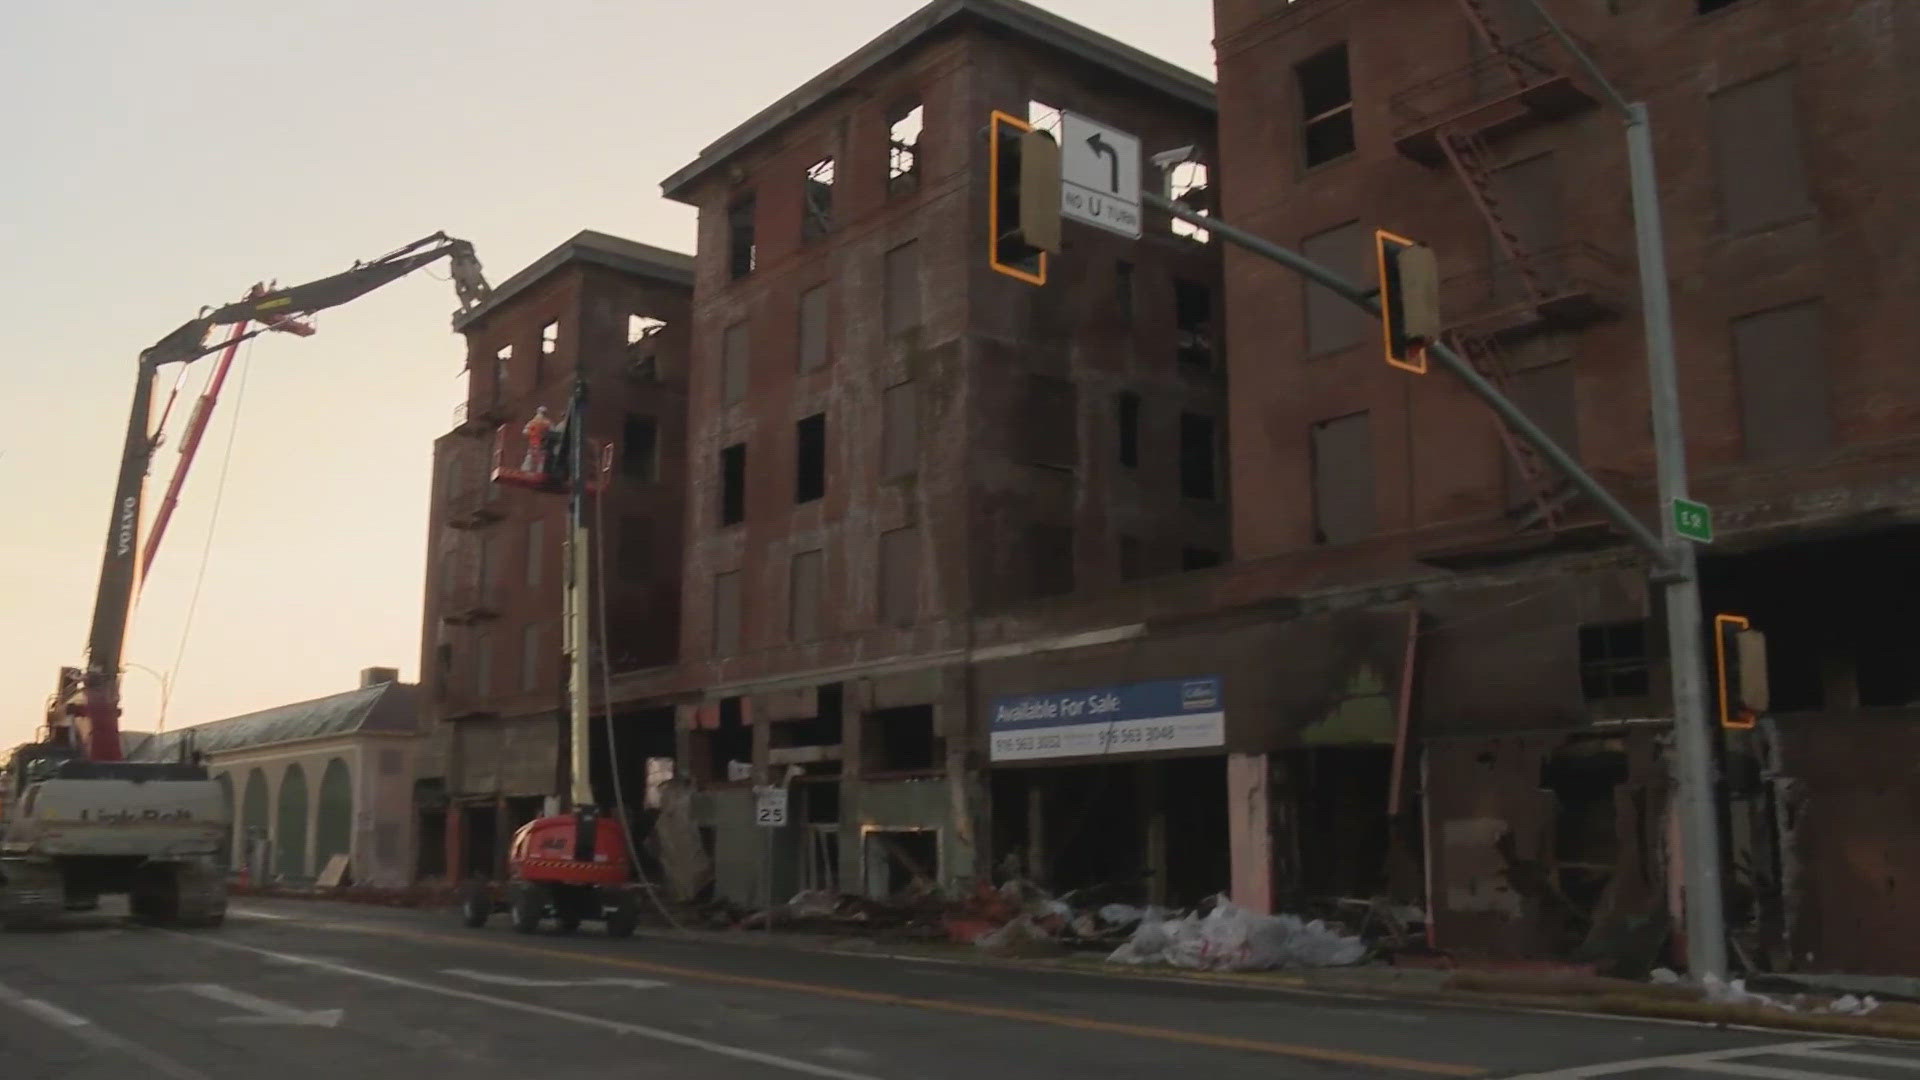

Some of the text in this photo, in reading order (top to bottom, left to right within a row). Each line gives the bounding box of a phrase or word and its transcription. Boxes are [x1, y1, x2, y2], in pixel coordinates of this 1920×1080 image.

[1065, 191, 1136, 225] NO U TURN
[117, 497, 136, 556] VOLVO
[994, 694, 1121, 722] Available For Sale
[760, 808, 782, 822] 25
